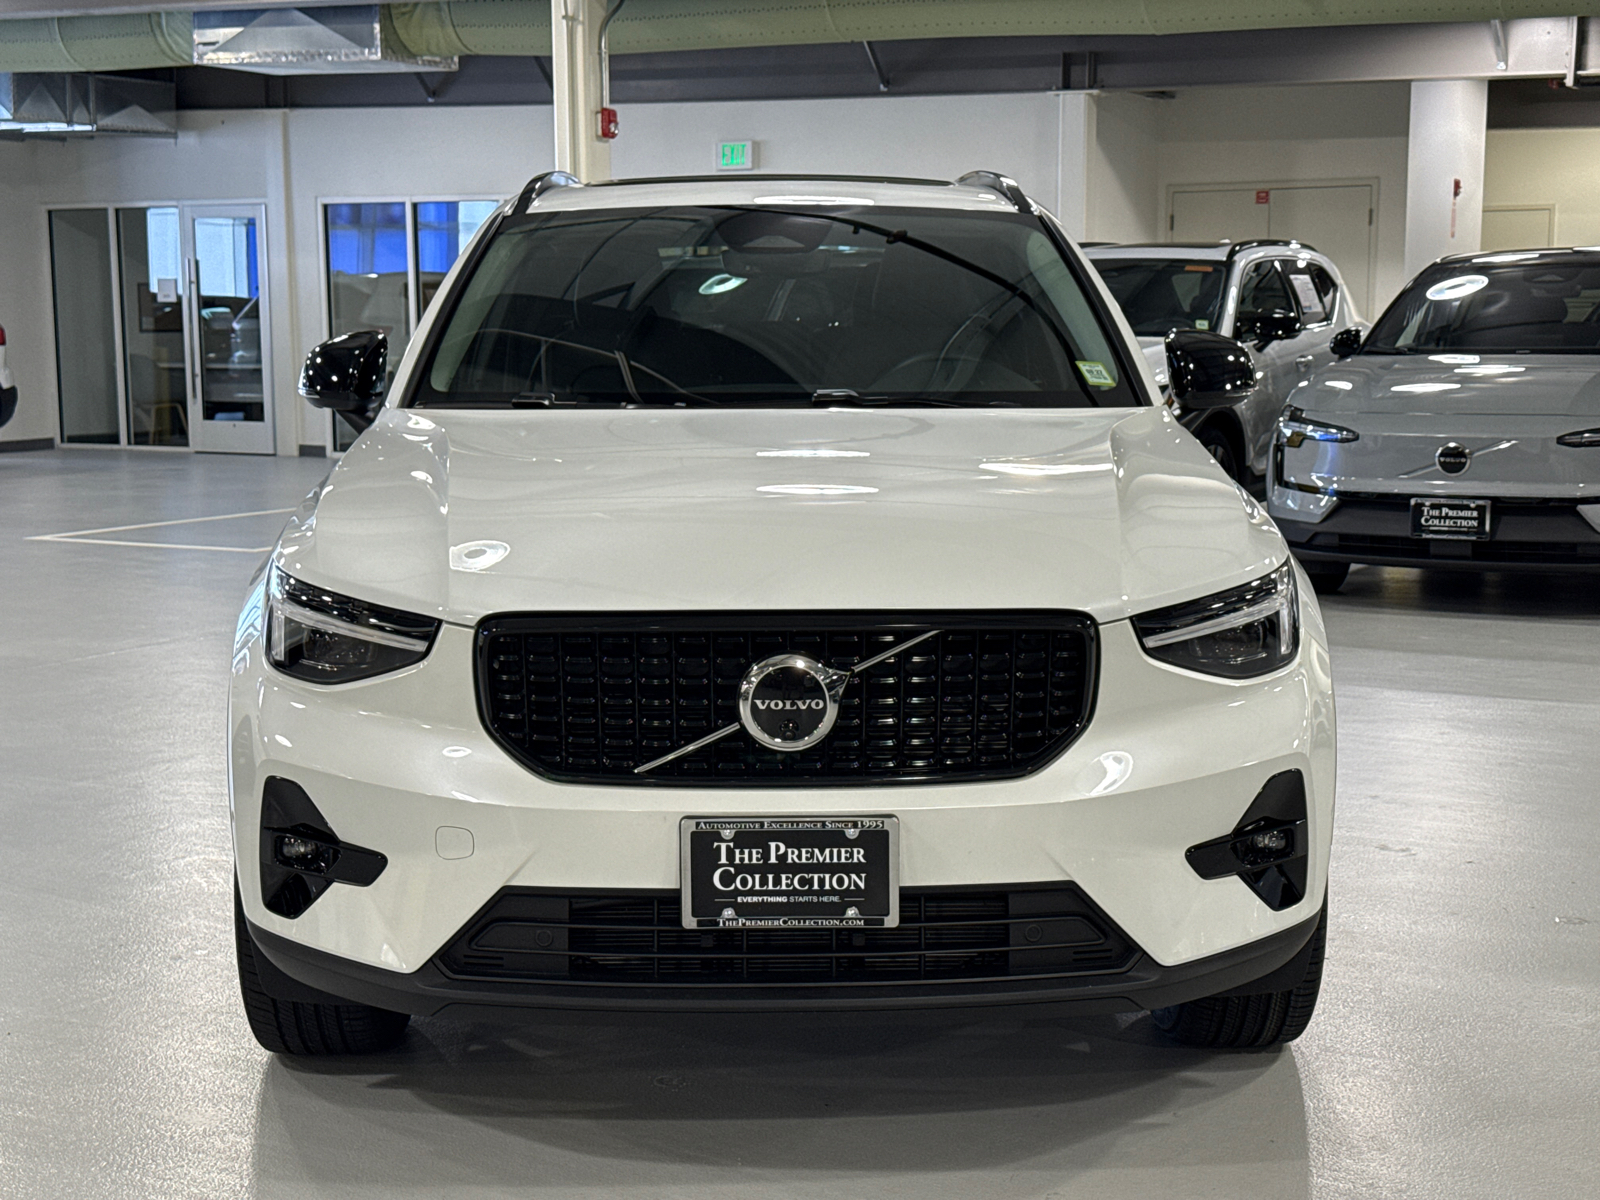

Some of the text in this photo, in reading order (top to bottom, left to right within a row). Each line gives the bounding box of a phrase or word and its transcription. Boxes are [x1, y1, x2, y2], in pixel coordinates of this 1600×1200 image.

[722, 144, 746, 166] EXIT
[1421, 507, 1478, 517] THE PREMIER
[1421, 516, 1478, 527] COLLECTION
[753, 699, 824, 710] VOLVO
[763, 821, 823, 829] EXCELLENCE
[825, 821, 854, 829] SINCE
[857, 820, 883, 829] 1995
[713, 841, 867, 865] THE PREMIER
[712, 866, 867, 891] COLLECTION
